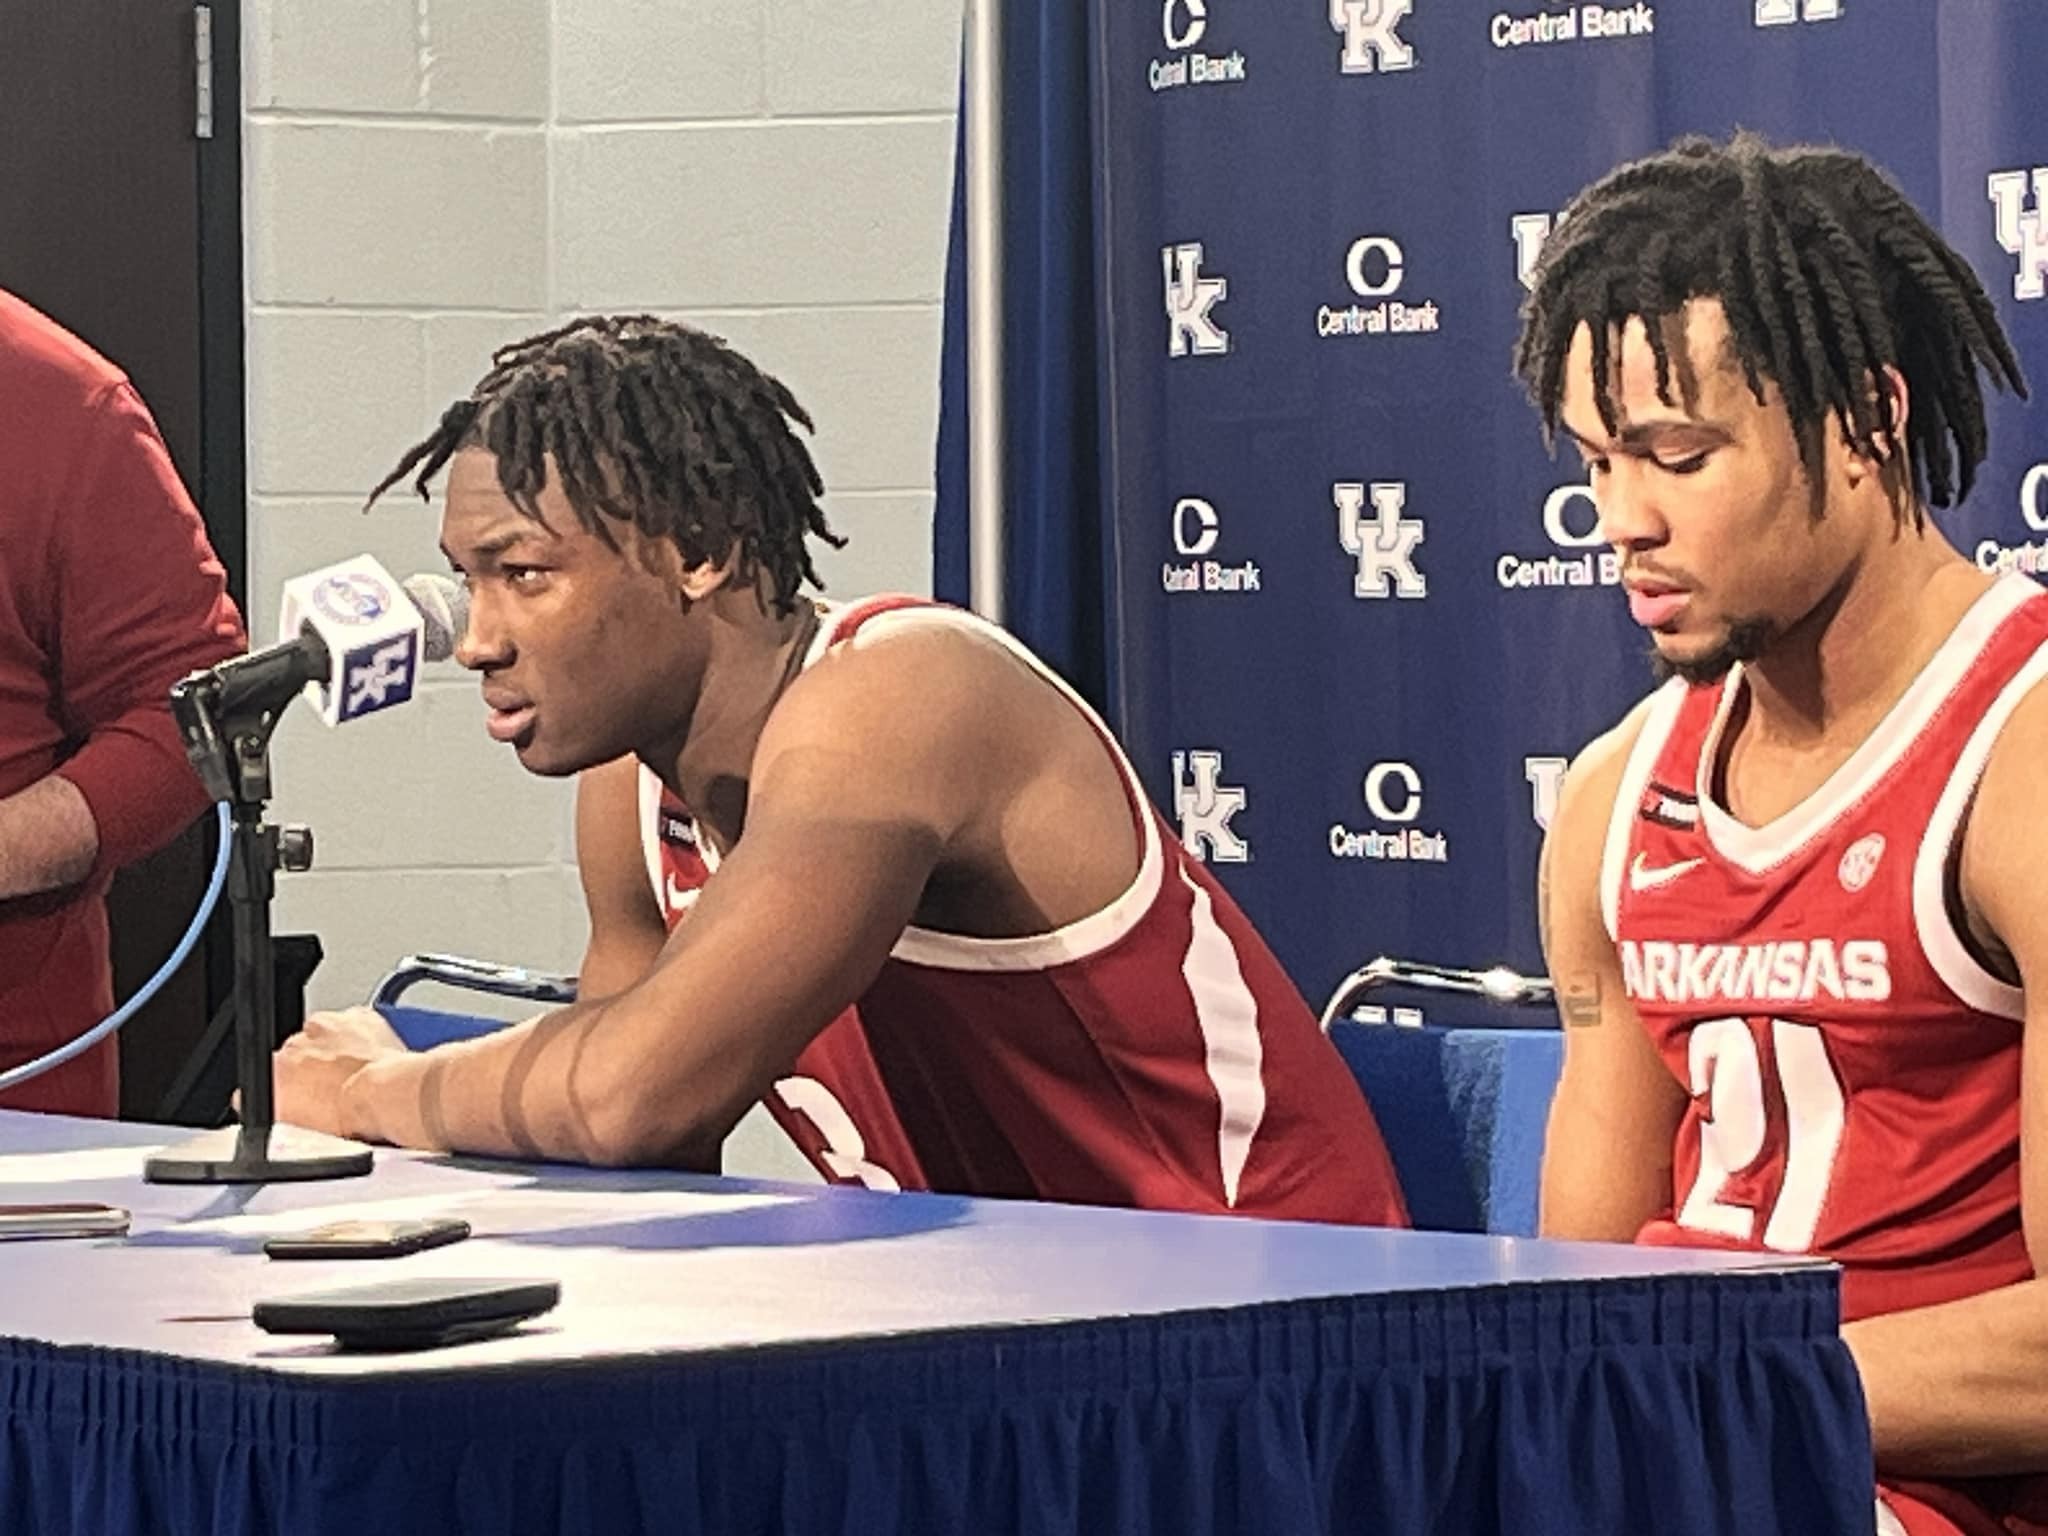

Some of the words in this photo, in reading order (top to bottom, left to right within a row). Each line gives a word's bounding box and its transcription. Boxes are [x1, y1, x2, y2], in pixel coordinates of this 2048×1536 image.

[1491, 8, 1577, 47] Central
[1582, 2, 1653, 38] Bank
[1346, 237, 1403, 296] C
[1318, 302, 1387, 336] Central
[1389, 299, 1439, 332] Bank
[1333, 483, 1426, 598] UK
[1203, 560, 1260, 591] Bank
[1497, 552, 1594, 588] Central
[1365, 762, 1422, 821] C
[1329, 824, 1408, 859] Central
[1620, 938, 1892, 1002] ARKANSAS
[1677, 1016, 1846, 1251] 21
